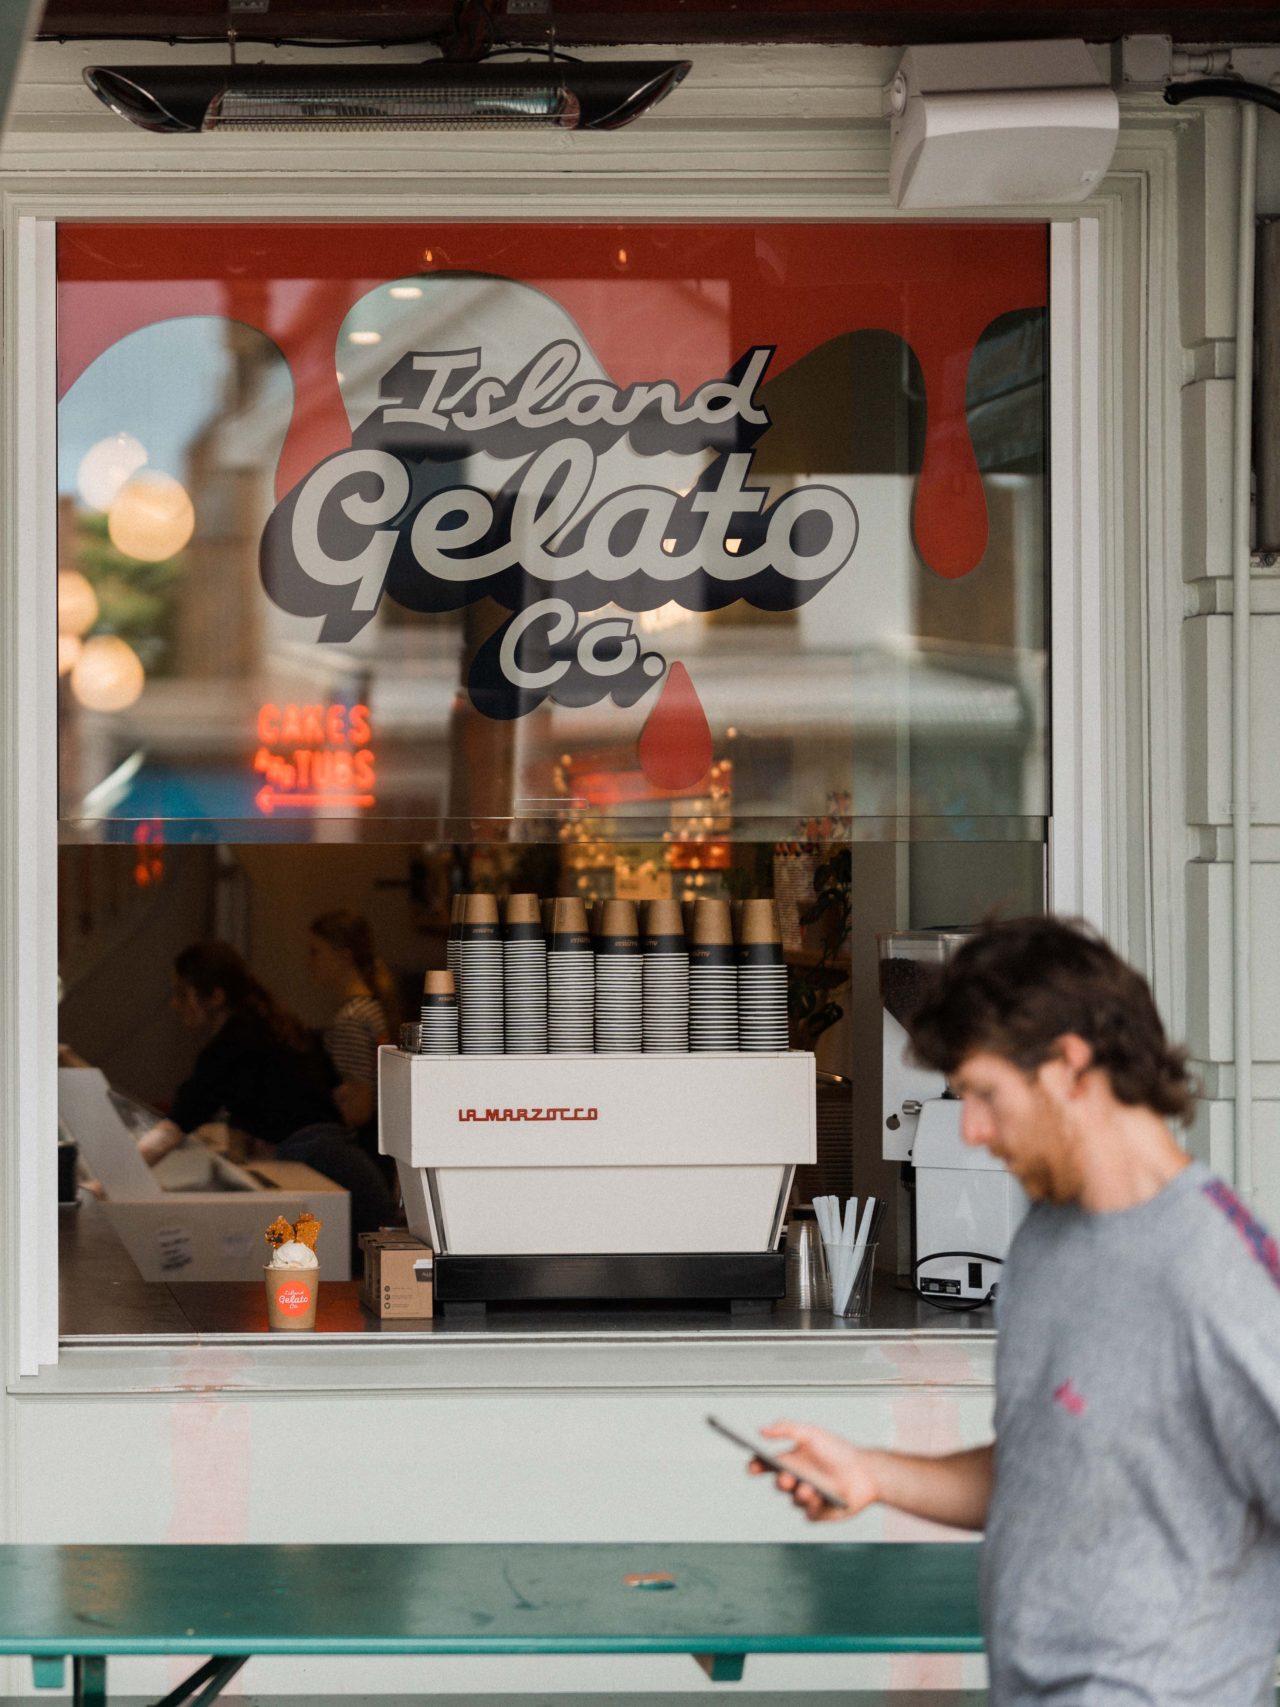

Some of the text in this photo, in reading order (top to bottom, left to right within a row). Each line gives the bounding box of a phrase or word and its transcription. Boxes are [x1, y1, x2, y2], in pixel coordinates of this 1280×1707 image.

[380, 339, 772, 432] Island
[290, 437, 860, 611] Gelato
[499, 597, 667, 689] Co.
[257, 703, 372, 744] CAKES
[458, 1108, 477, 1122] LA
[278, 1295, 309, 1304] Gelato
